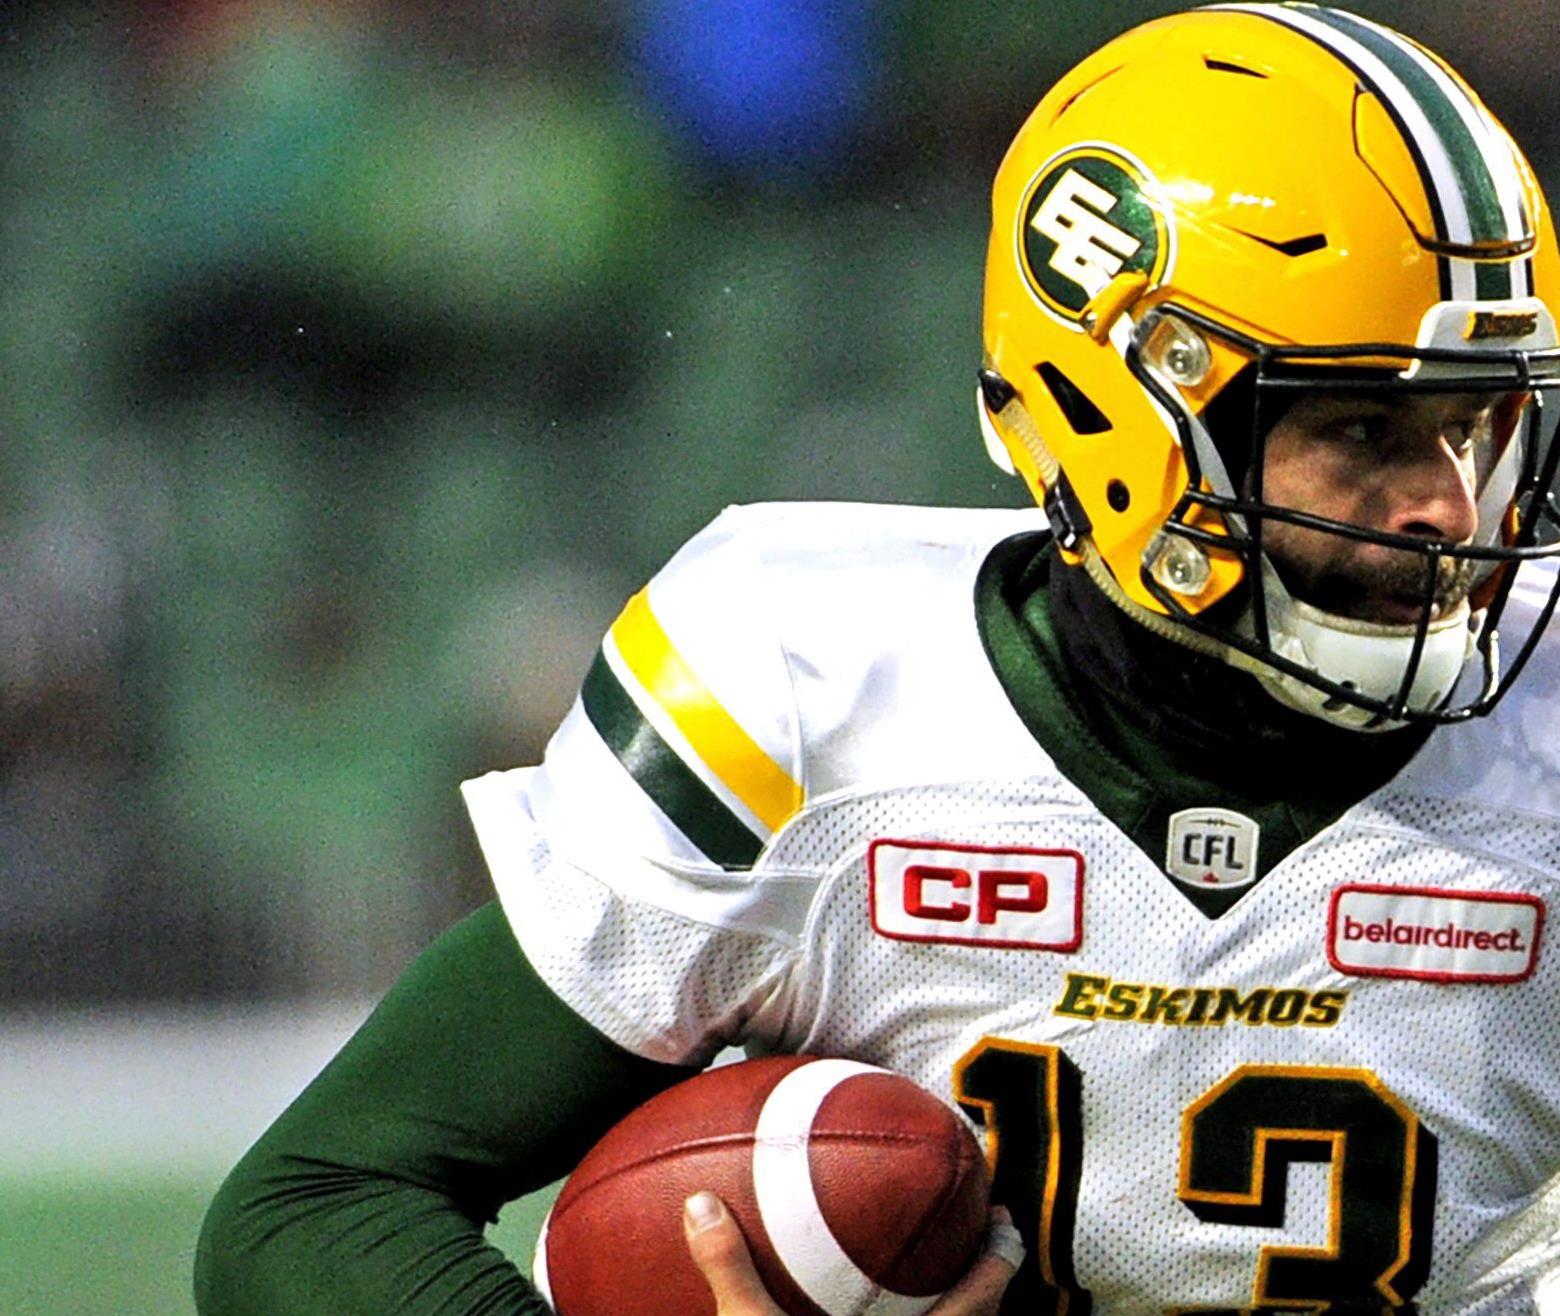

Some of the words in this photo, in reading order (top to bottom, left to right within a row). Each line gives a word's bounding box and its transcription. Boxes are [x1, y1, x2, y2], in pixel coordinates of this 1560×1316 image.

[1183, 833, 1243, 870] CFL
[903, 865, 1048, 924] CP
[1343, 916, 1527, 953] belairdirect.
[1054, 972, 1354, 1028] ESKIMOS
